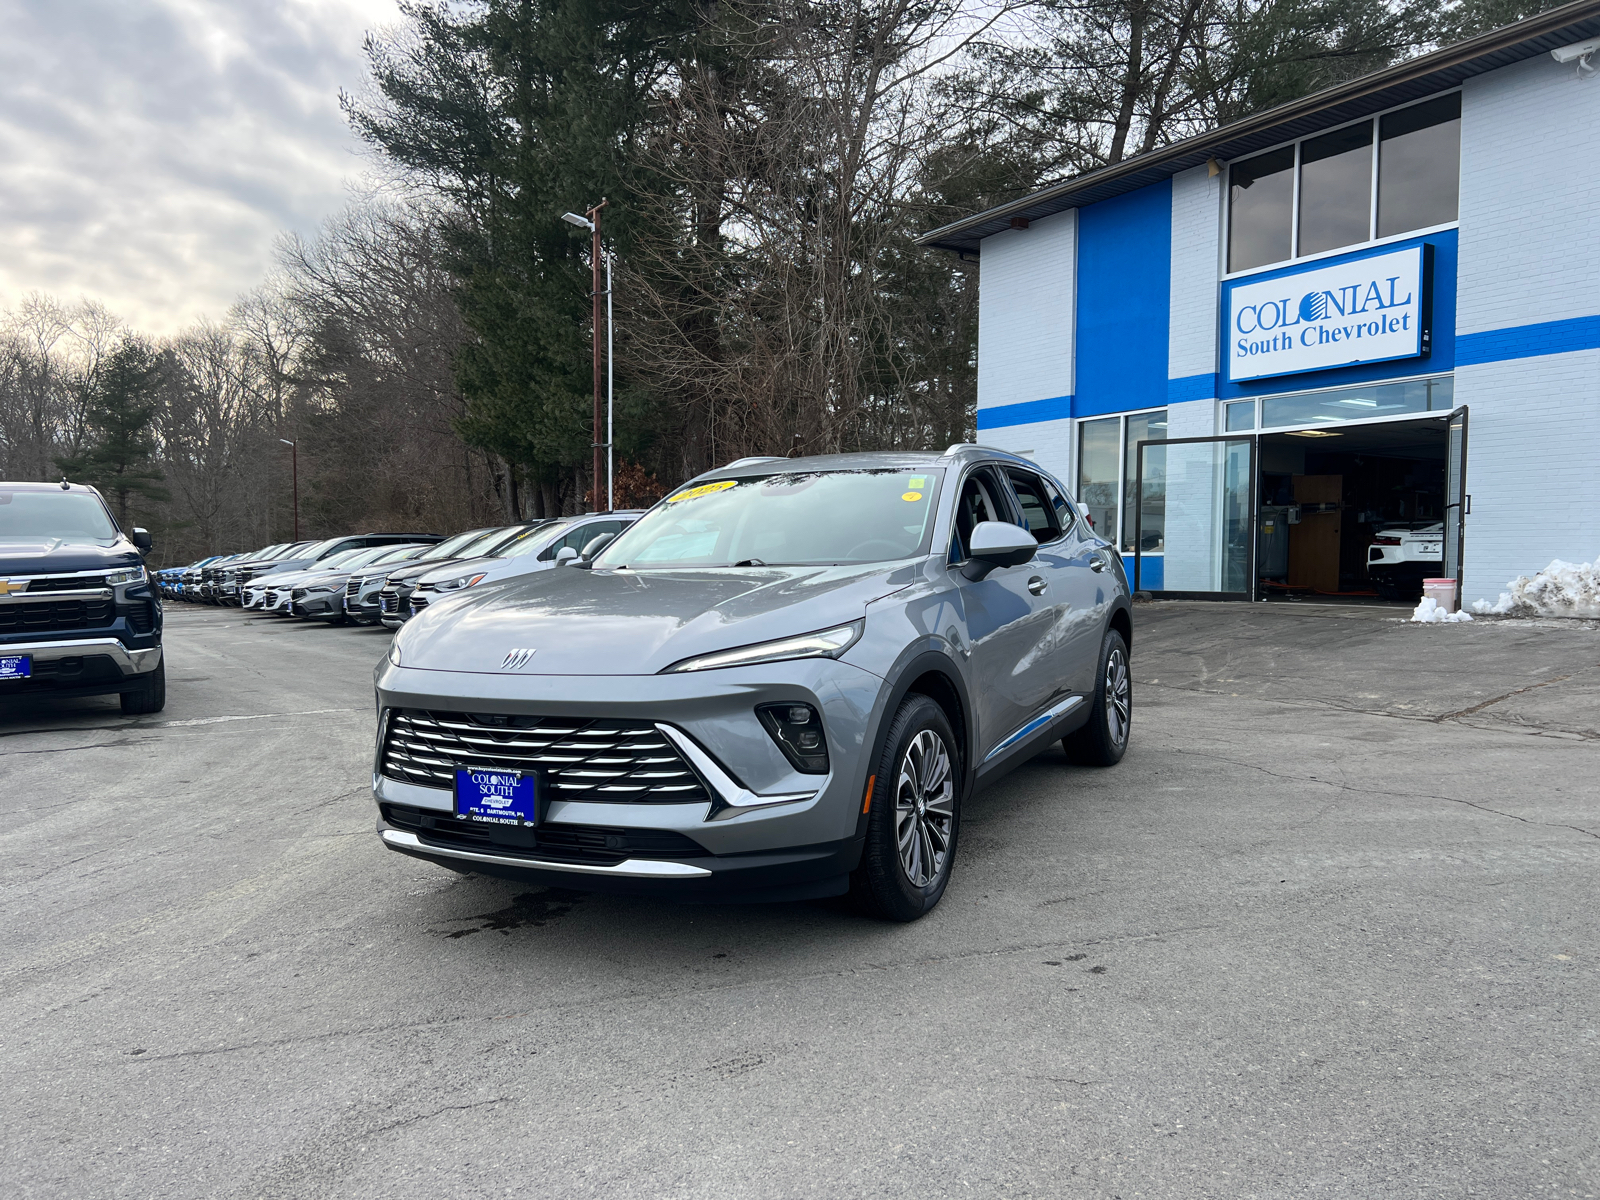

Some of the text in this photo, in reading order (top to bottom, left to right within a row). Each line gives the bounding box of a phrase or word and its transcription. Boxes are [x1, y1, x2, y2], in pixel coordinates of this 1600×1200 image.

[1236, 276, 1412, 334] COLONIAL
[1236, 332, 1293, 358] South
[1300, 312, 1411, 347] Chevrolet
[472, 774, 521, 786] COLONIAL
[480, 785, 513, 796] SOUTH
